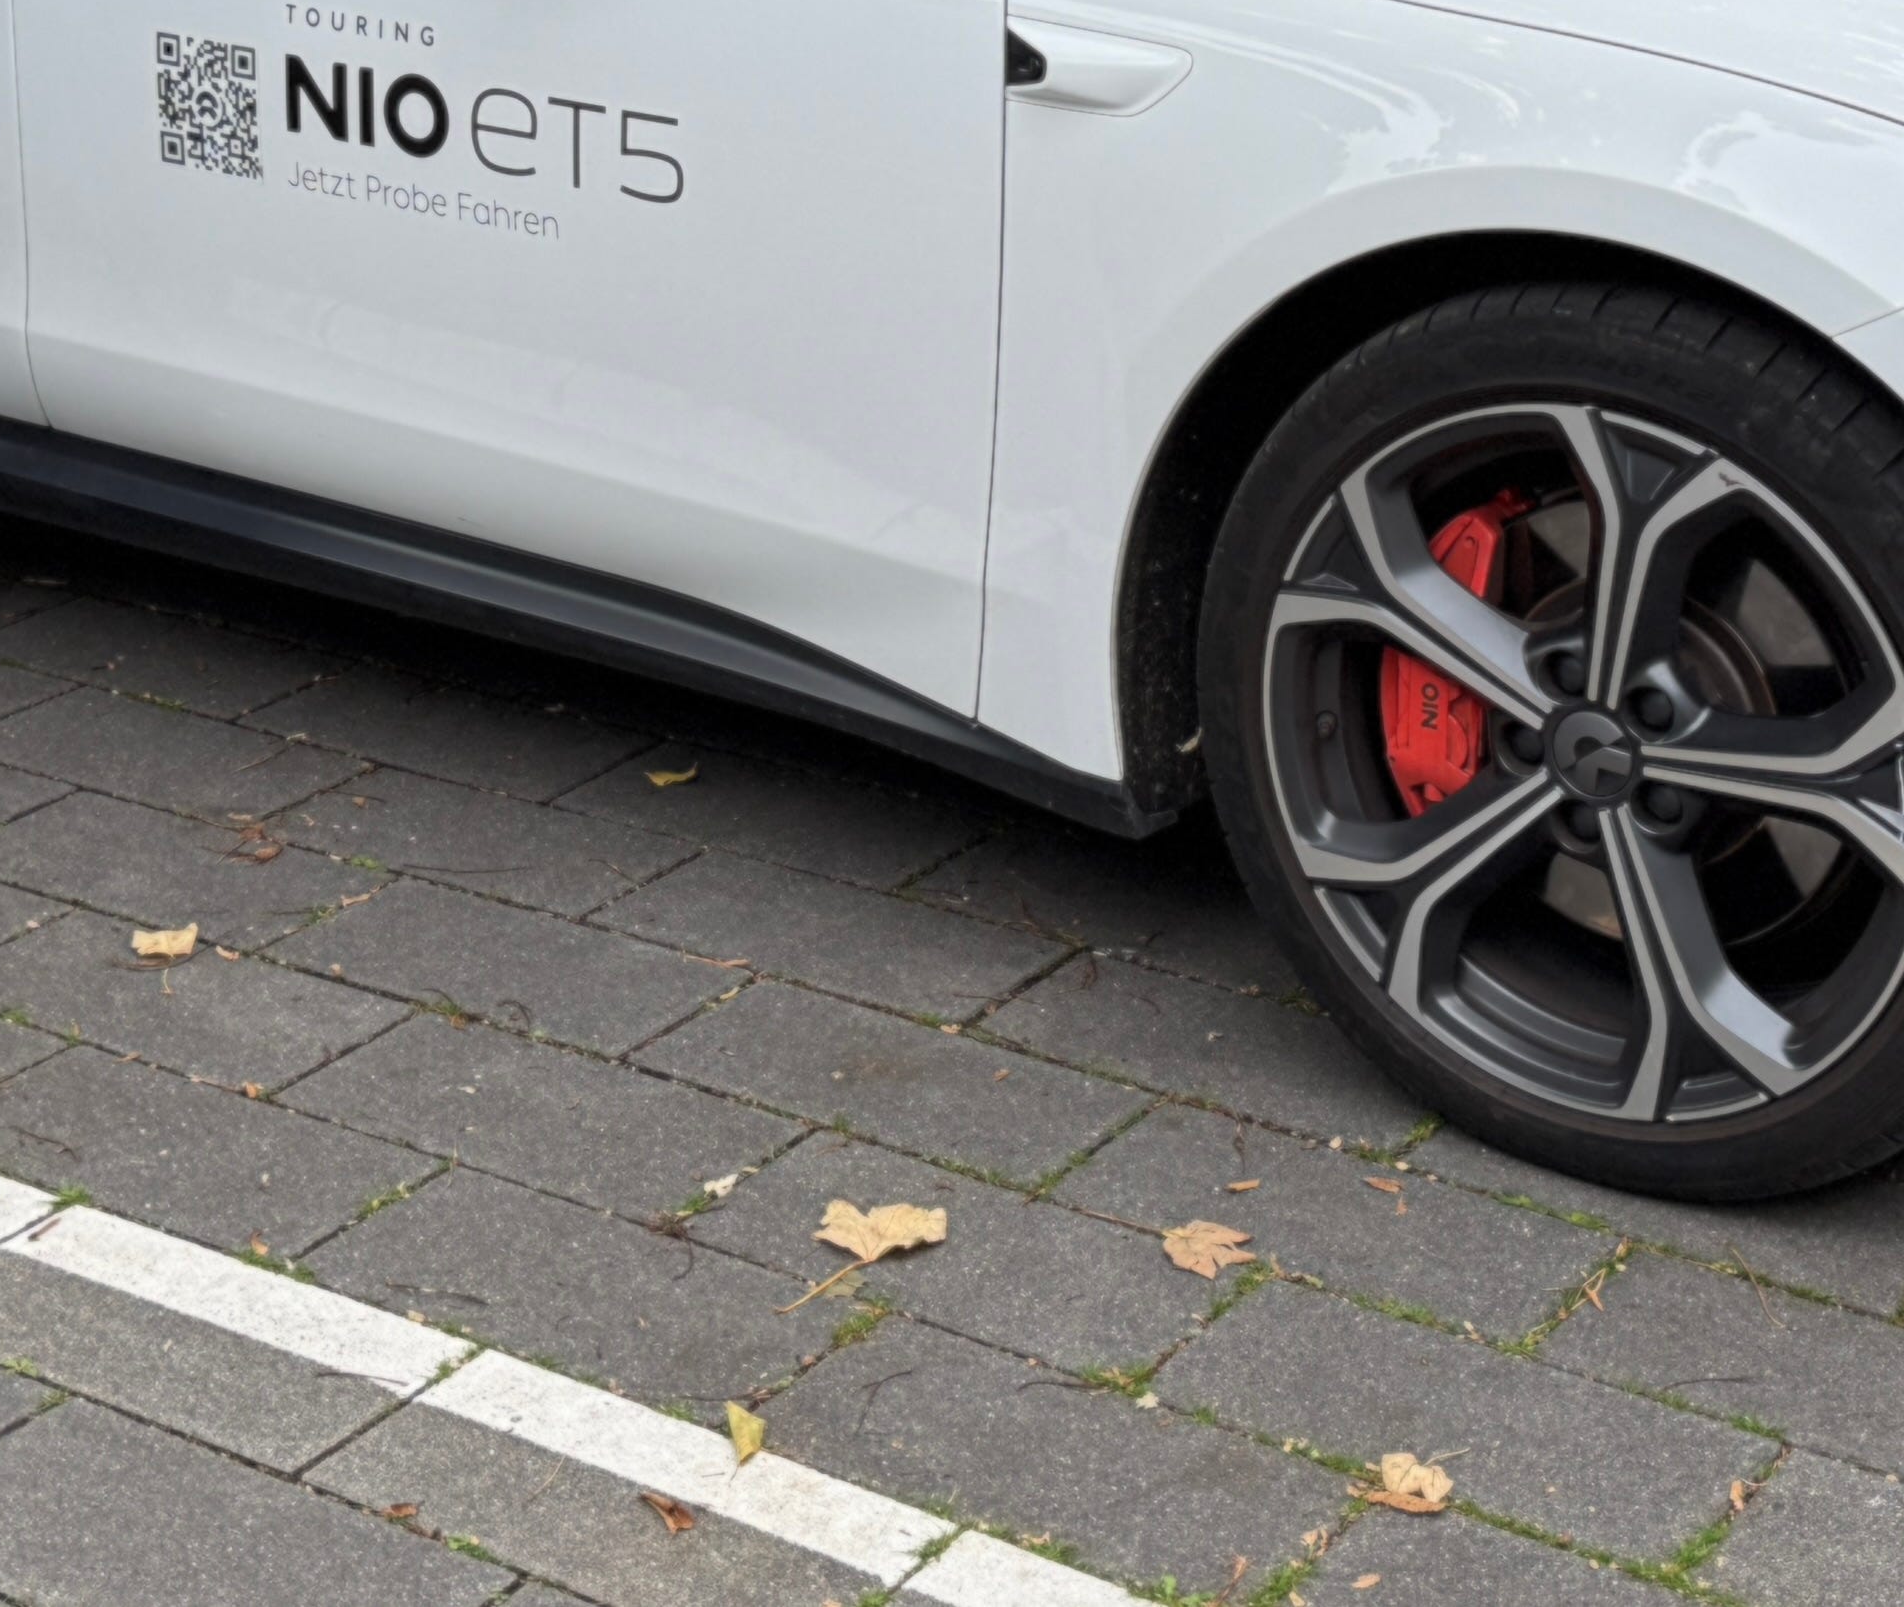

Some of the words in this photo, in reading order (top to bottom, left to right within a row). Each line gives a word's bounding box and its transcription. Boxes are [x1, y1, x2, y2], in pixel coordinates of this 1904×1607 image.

[284, 2, 435, 47] TOURING
[284, 52, 450, 160] NIO
[287, 161, 357, 201] Jetzt
[365, 173, 449, 218] Probe
[457, 191, 561, 241] Fahren
[1421, 682, 1440, 730] NIO
